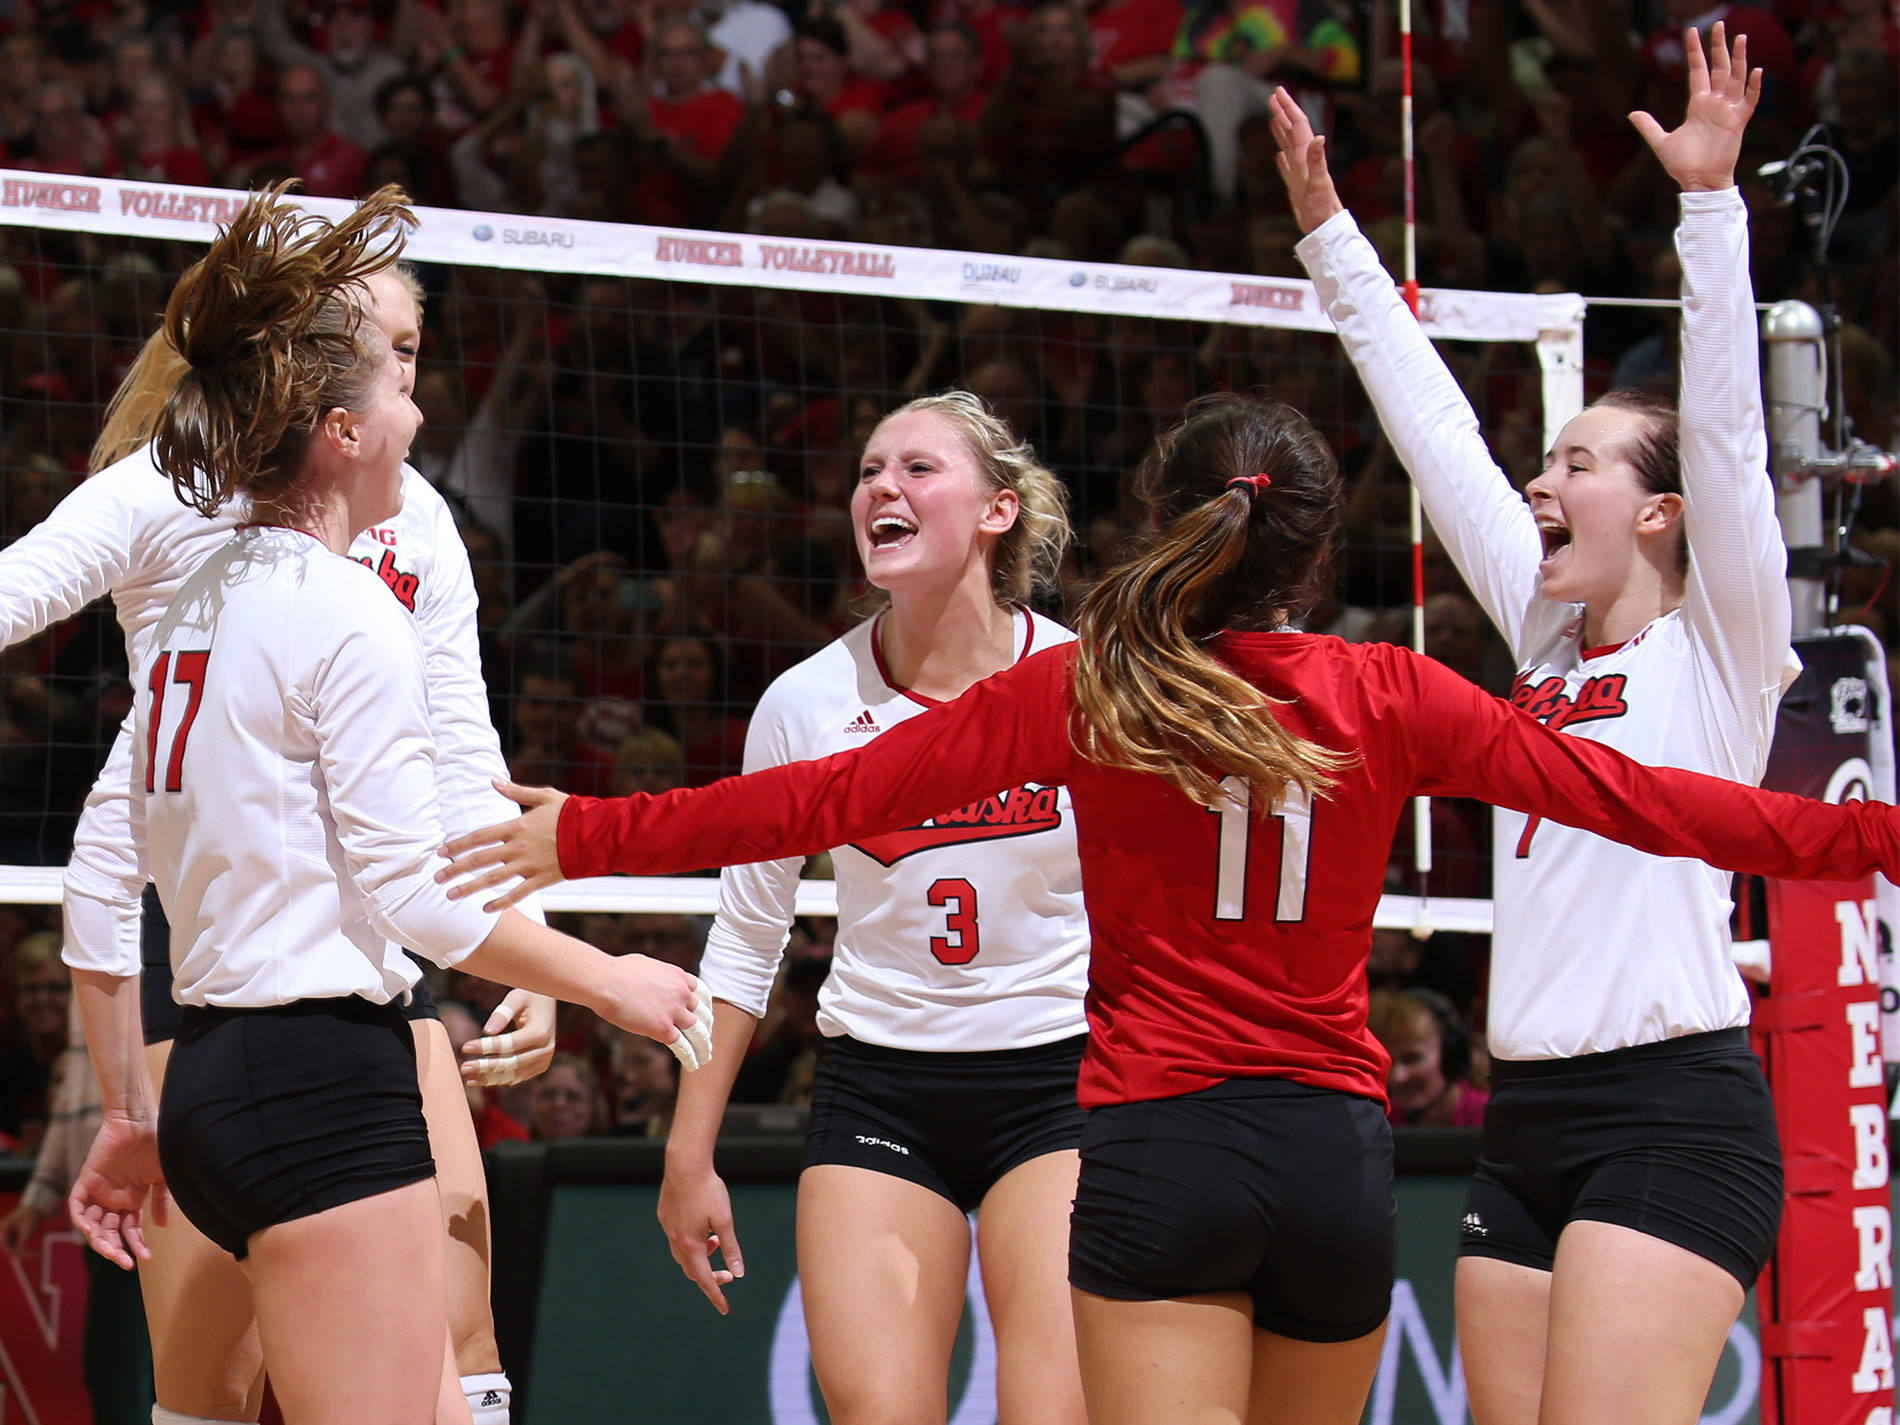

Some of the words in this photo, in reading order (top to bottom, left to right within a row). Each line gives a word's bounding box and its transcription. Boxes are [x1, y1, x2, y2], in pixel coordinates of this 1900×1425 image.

[2, 179, 101, 214] HUSKER
[502, 228, 576, 249] SUBARU
[655, 236, 744, 267] HUSKER
[758, 244, 896, 279] VOLLEYBALL
[145, 649, 212, 793] 17
[843, 723, 881, 734] adidas
[1207, 773, 1316, 923] 11
[926, 877, 981, 966] 3
[855, 1134, 910, 1156] adidas
[1834, 897, 1897, 1425] NEBRA
